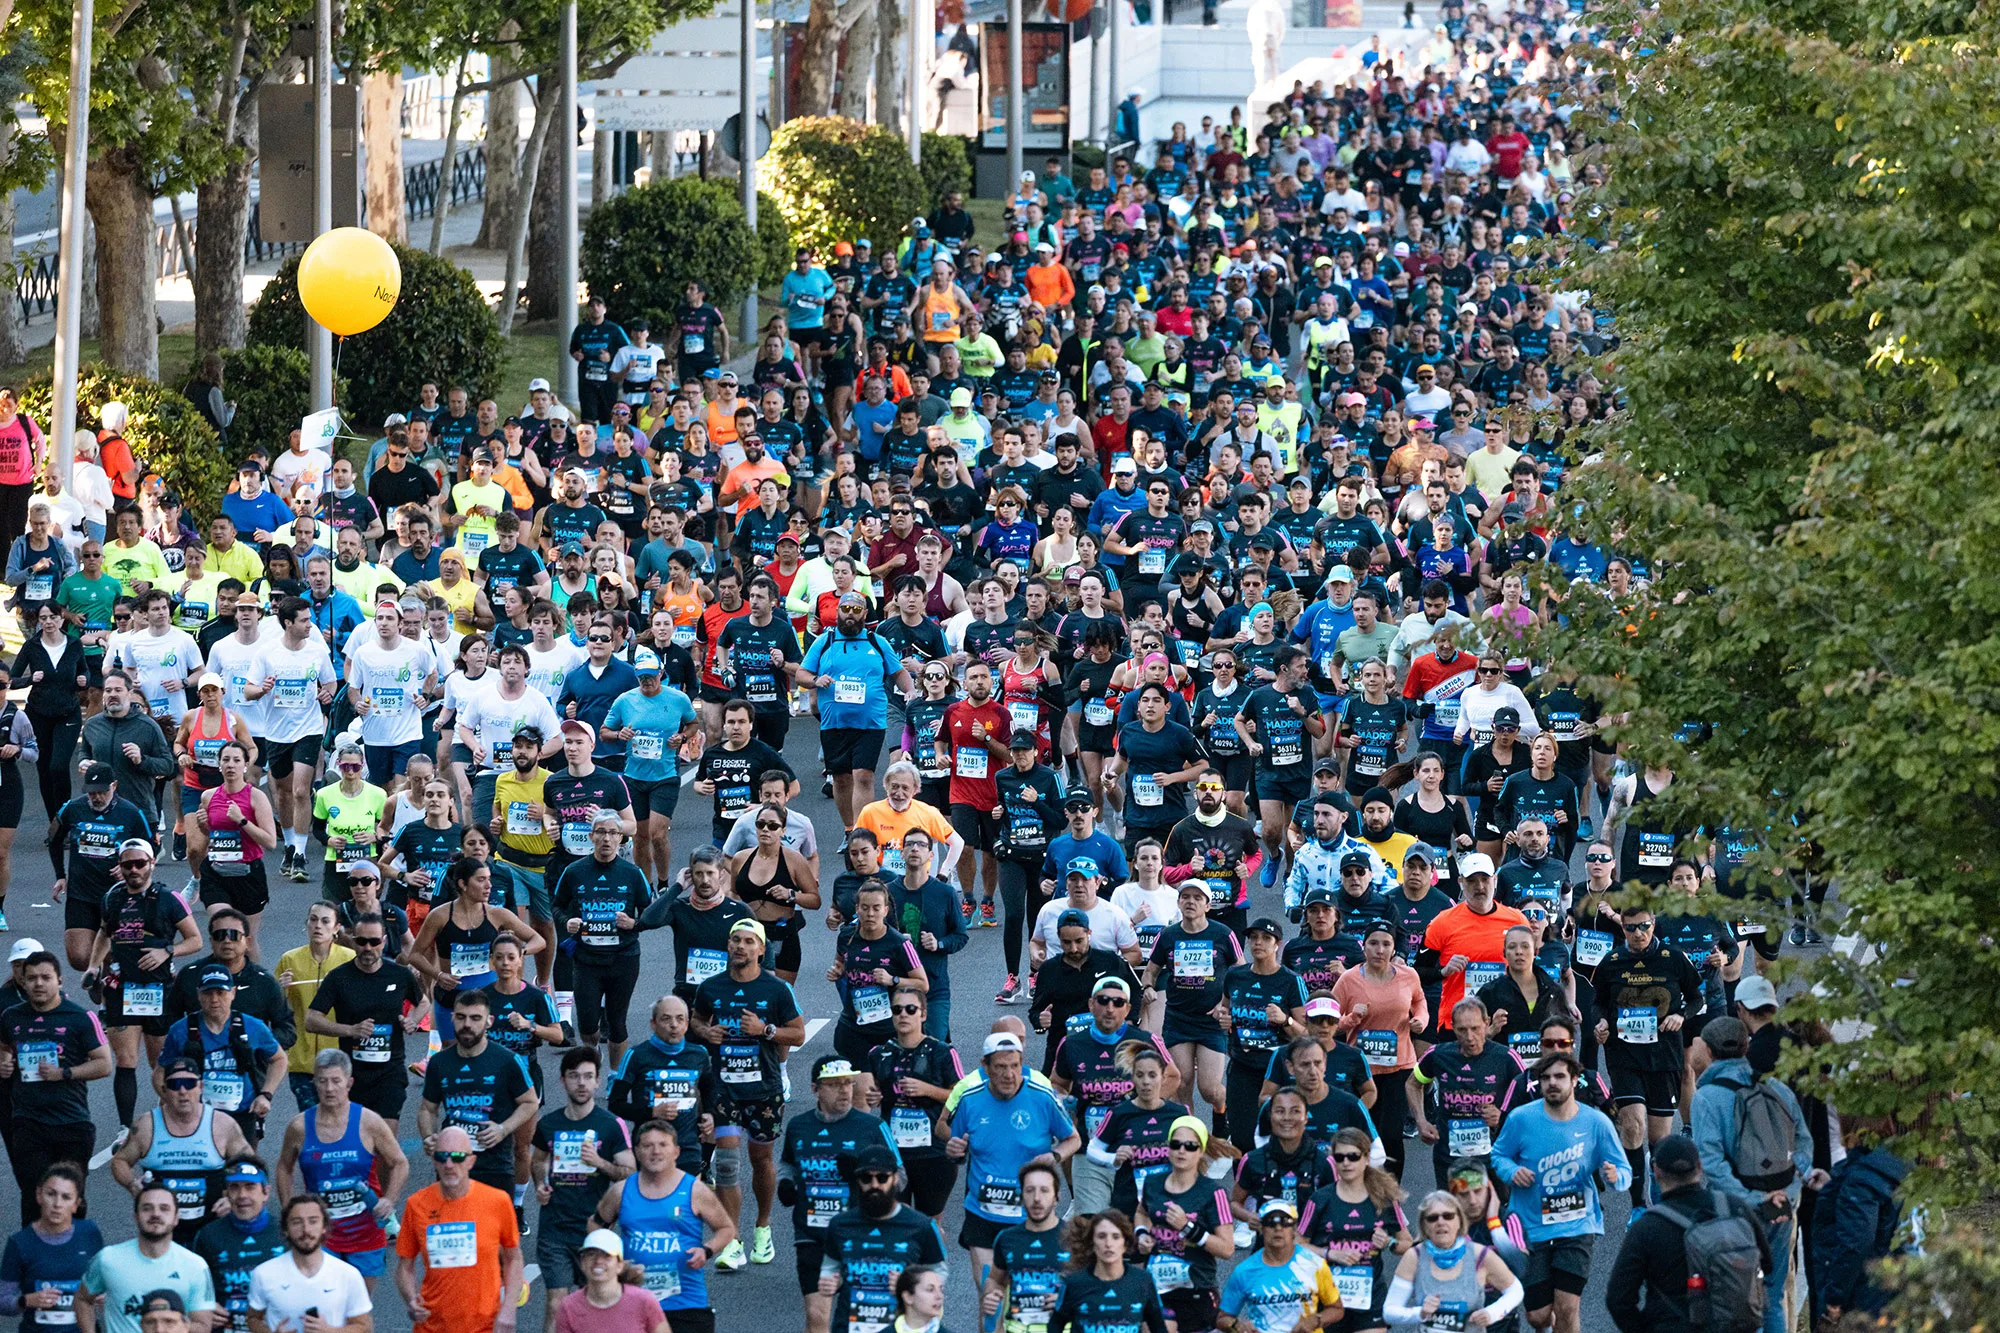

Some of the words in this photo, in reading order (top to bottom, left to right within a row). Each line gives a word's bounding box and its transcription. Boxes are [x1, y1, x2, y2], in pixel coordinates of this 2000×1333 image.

[1325, 541, 1358, 549] MADRID
[369, 670, 395, 678] CADETE
[751, 684, 769, 692] 37131
[841, 683, 860, 692] 10833
[1435, 676, 1462, 696] ATLETICA
[281, 688, 300, 696] 10860
[1437, 681, 1466, 702] CINISELLO
[380, 698, 395, 706] 3825
[1014, 711, 1029, 721] 8961
[1089, 707, 1108, 716] 10853
[1443, 708, 1459, 717] 9863
[486, 718, 511, 729] CADETE
[1266, 720, 1303, 730] MADRID
[1554, 722, 1574, 731] 38855
[1358, 731, 1393, 741] MADRID
[1478, 732, 1494, 741] 3597
[639, 738, 654, 747] 8797
[1214, 738, 1234, 748] 40296
[1277, 745, 1297, 754] 36316
[499, 751, 513, 760] 320
[964, 756, 978, 765] 9181
[1362, 756, 1381, 765] 36317
[924, 759, 936, 767] 353
[725, 798, 745, 807] 38266
[1021, 818, 1038, 826] ZURICH
[86, 833, 109, 844] 32218
[571, 833, 587, 843] 9085
[1646, 843, 1667, 853] 32703
[343, 850, 364, 859] 39441
[582, 902, 626, 912] MADRID
[588, 923, 611, 932] 36354
[1589, 932, 1609, 940] ZURICH
[1584, 941, 1603, 952] 8900
[461, 953, 479, 962] 9167
[1184, 953, 1202, 962] 6727
[695, 961, 718, 971] 10055
[132, 992, 154, 1001] 10021
[859, 997, 882, 1010] 10056
[1232, 1007, 1267, 1020] MADR
[1627, 1020, 1646, 1030] 4741
[488, 1031, 533, 1042] MADRID
[1364, 1040, 1389, 1051] 39182
[1517, 1044, 1541, 1055] 40405
[727, 1058, 752, 1068] 36982
[213, 1084, 233, 1094] 9293
[663, 1083, 689, 1093] 35163
[1082, 1082, 1134, 1093] MADRID
[445, 1095, 493, 1108] MADRID
[1444, 1092, 1495, 1105] MADRID
[900, 1121, 920, 1132] 9469
[1456, 1132, 1482, 1142] 10420
[158, 1151, 209, 1159] PONTELAND
[322, 1151, 358, 1159] AYCLIFFE
[564, 1145, 580, 1156] 879
[163, 1158, 203, 1166] RUNNERS
[1538, 1142, 1584, 1173] CHOOSE
[330, 1163, 344, 1177] JP
[800, 1160, 838, 1172] MADR
[1543, 1161, 1580, 1187] GO
[986, 1188, 1013, 1200] 36077
[1556, 1184, 1577, 1194] ZURICH
[814, 1200, 840, 1211] 38515
[1550, 1196, 1577, 1209] 36894
[630, 1237, 681, 1253] ITALIA
[1329, 1241, 1371, 1252] MADR
[848, 1262, 904, 1275] MADRID
[1158, 1266, 1177, 1277] 8654
[1338, 1280, 1360, 1291] 8655
